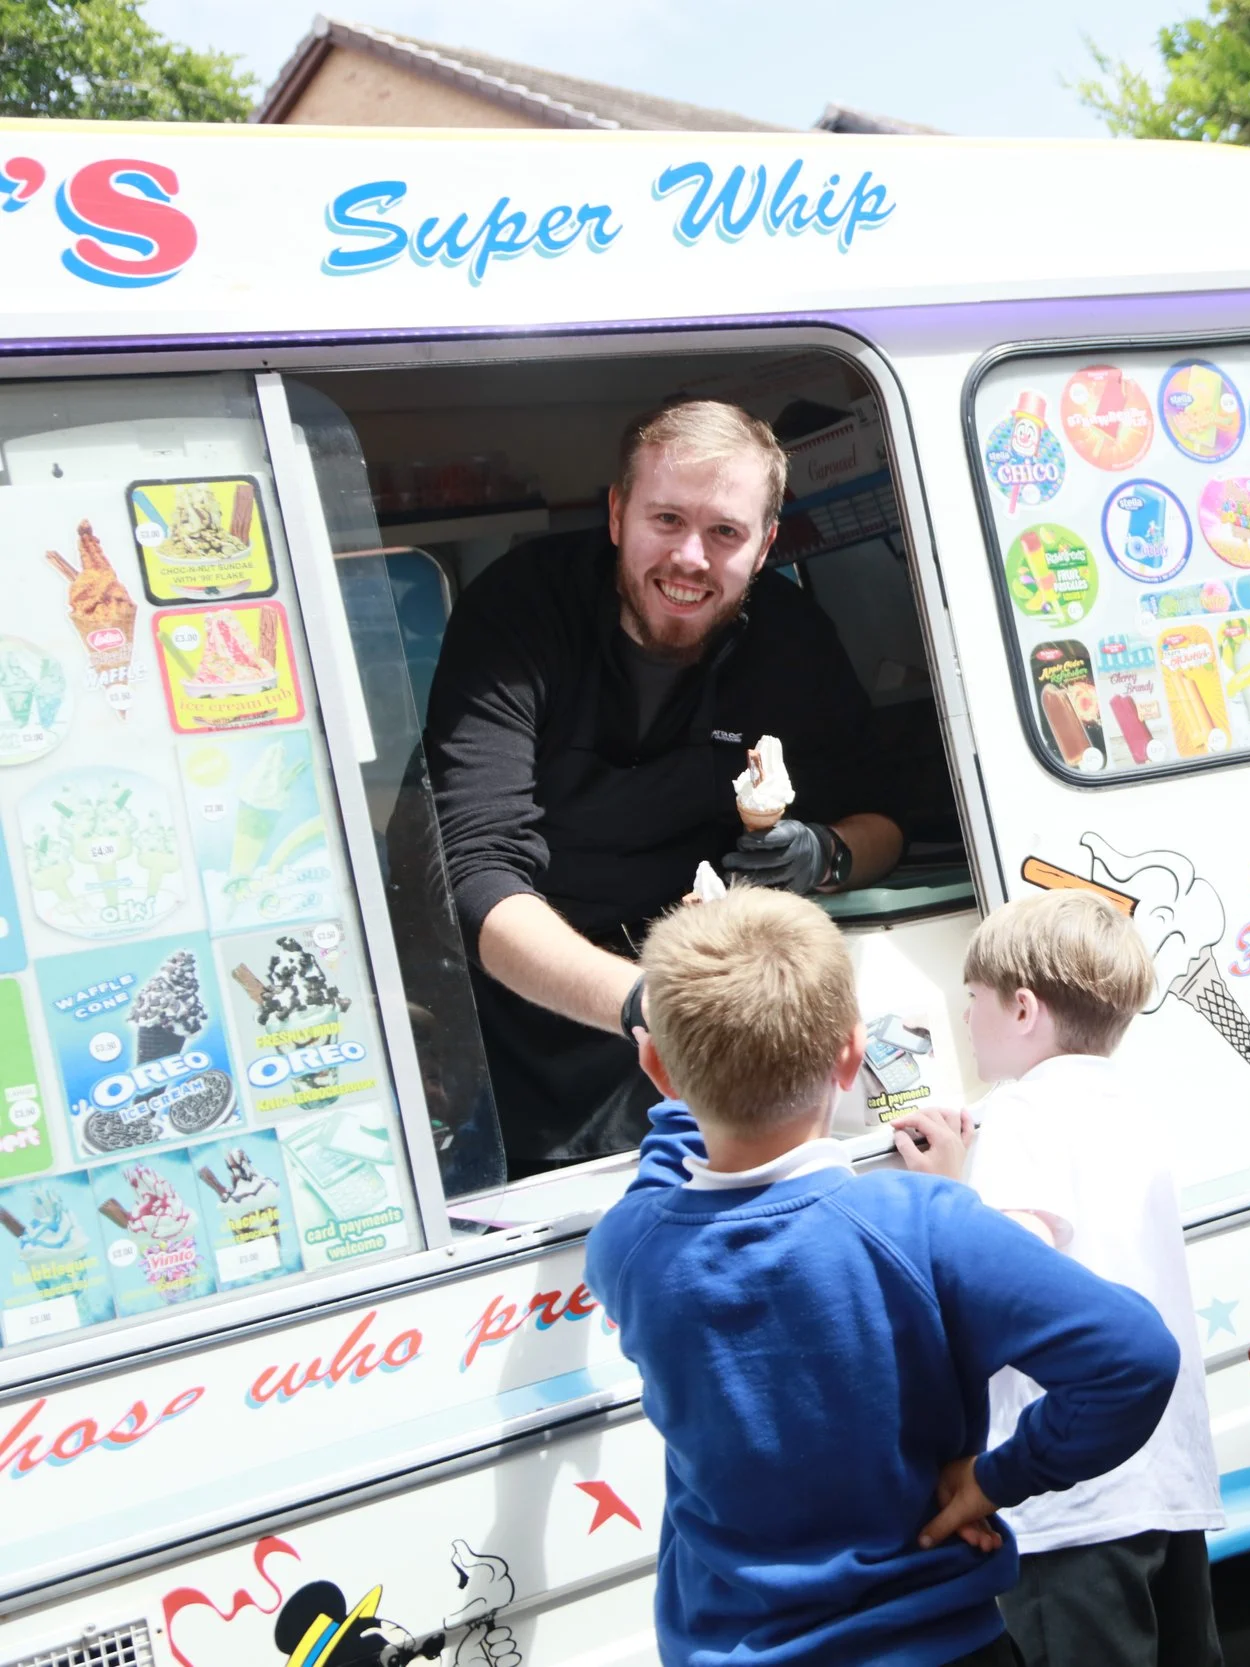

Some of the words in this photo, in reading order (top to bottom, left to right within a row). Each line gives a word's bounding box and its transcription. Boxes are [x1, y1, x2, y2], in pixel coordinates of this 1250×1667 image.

[320, 180, 623, 288] Super
[651, 158, 898, 254] Whip
[807, 440, 856, 483] Carousel
[214, 571, 245, 581] FLAKE
[1108, 671, 1138, 686] Cherry
[1124, 679, 1155, 696] Brandy
[180, 699, 205, 713] ice
[208, 698, 262, 713] cream
[265, 687, 293, 706] tub
[55, 974, 134, 1011] WAFFLE
[74, 991, 130, 1019] CONE
[255, 1026, 311, 1048] FRESHLY
[248, 1041, 366, 1088] OREO
[92, 1050, 210, 1108] OREO
[120, 1102, 149, 1123] ICE
[149, 1078, 205, 1111] CREAM
[887, 1085, 930, 1108] payments
[307, 1225, 336, 1242] card
[338, 1209, 402, 1235] payments
[150, 1249, 196, 1271] Vimto
[328, 1235, 384, 1260] welcome
[245, 1309, 424, 1409] who
